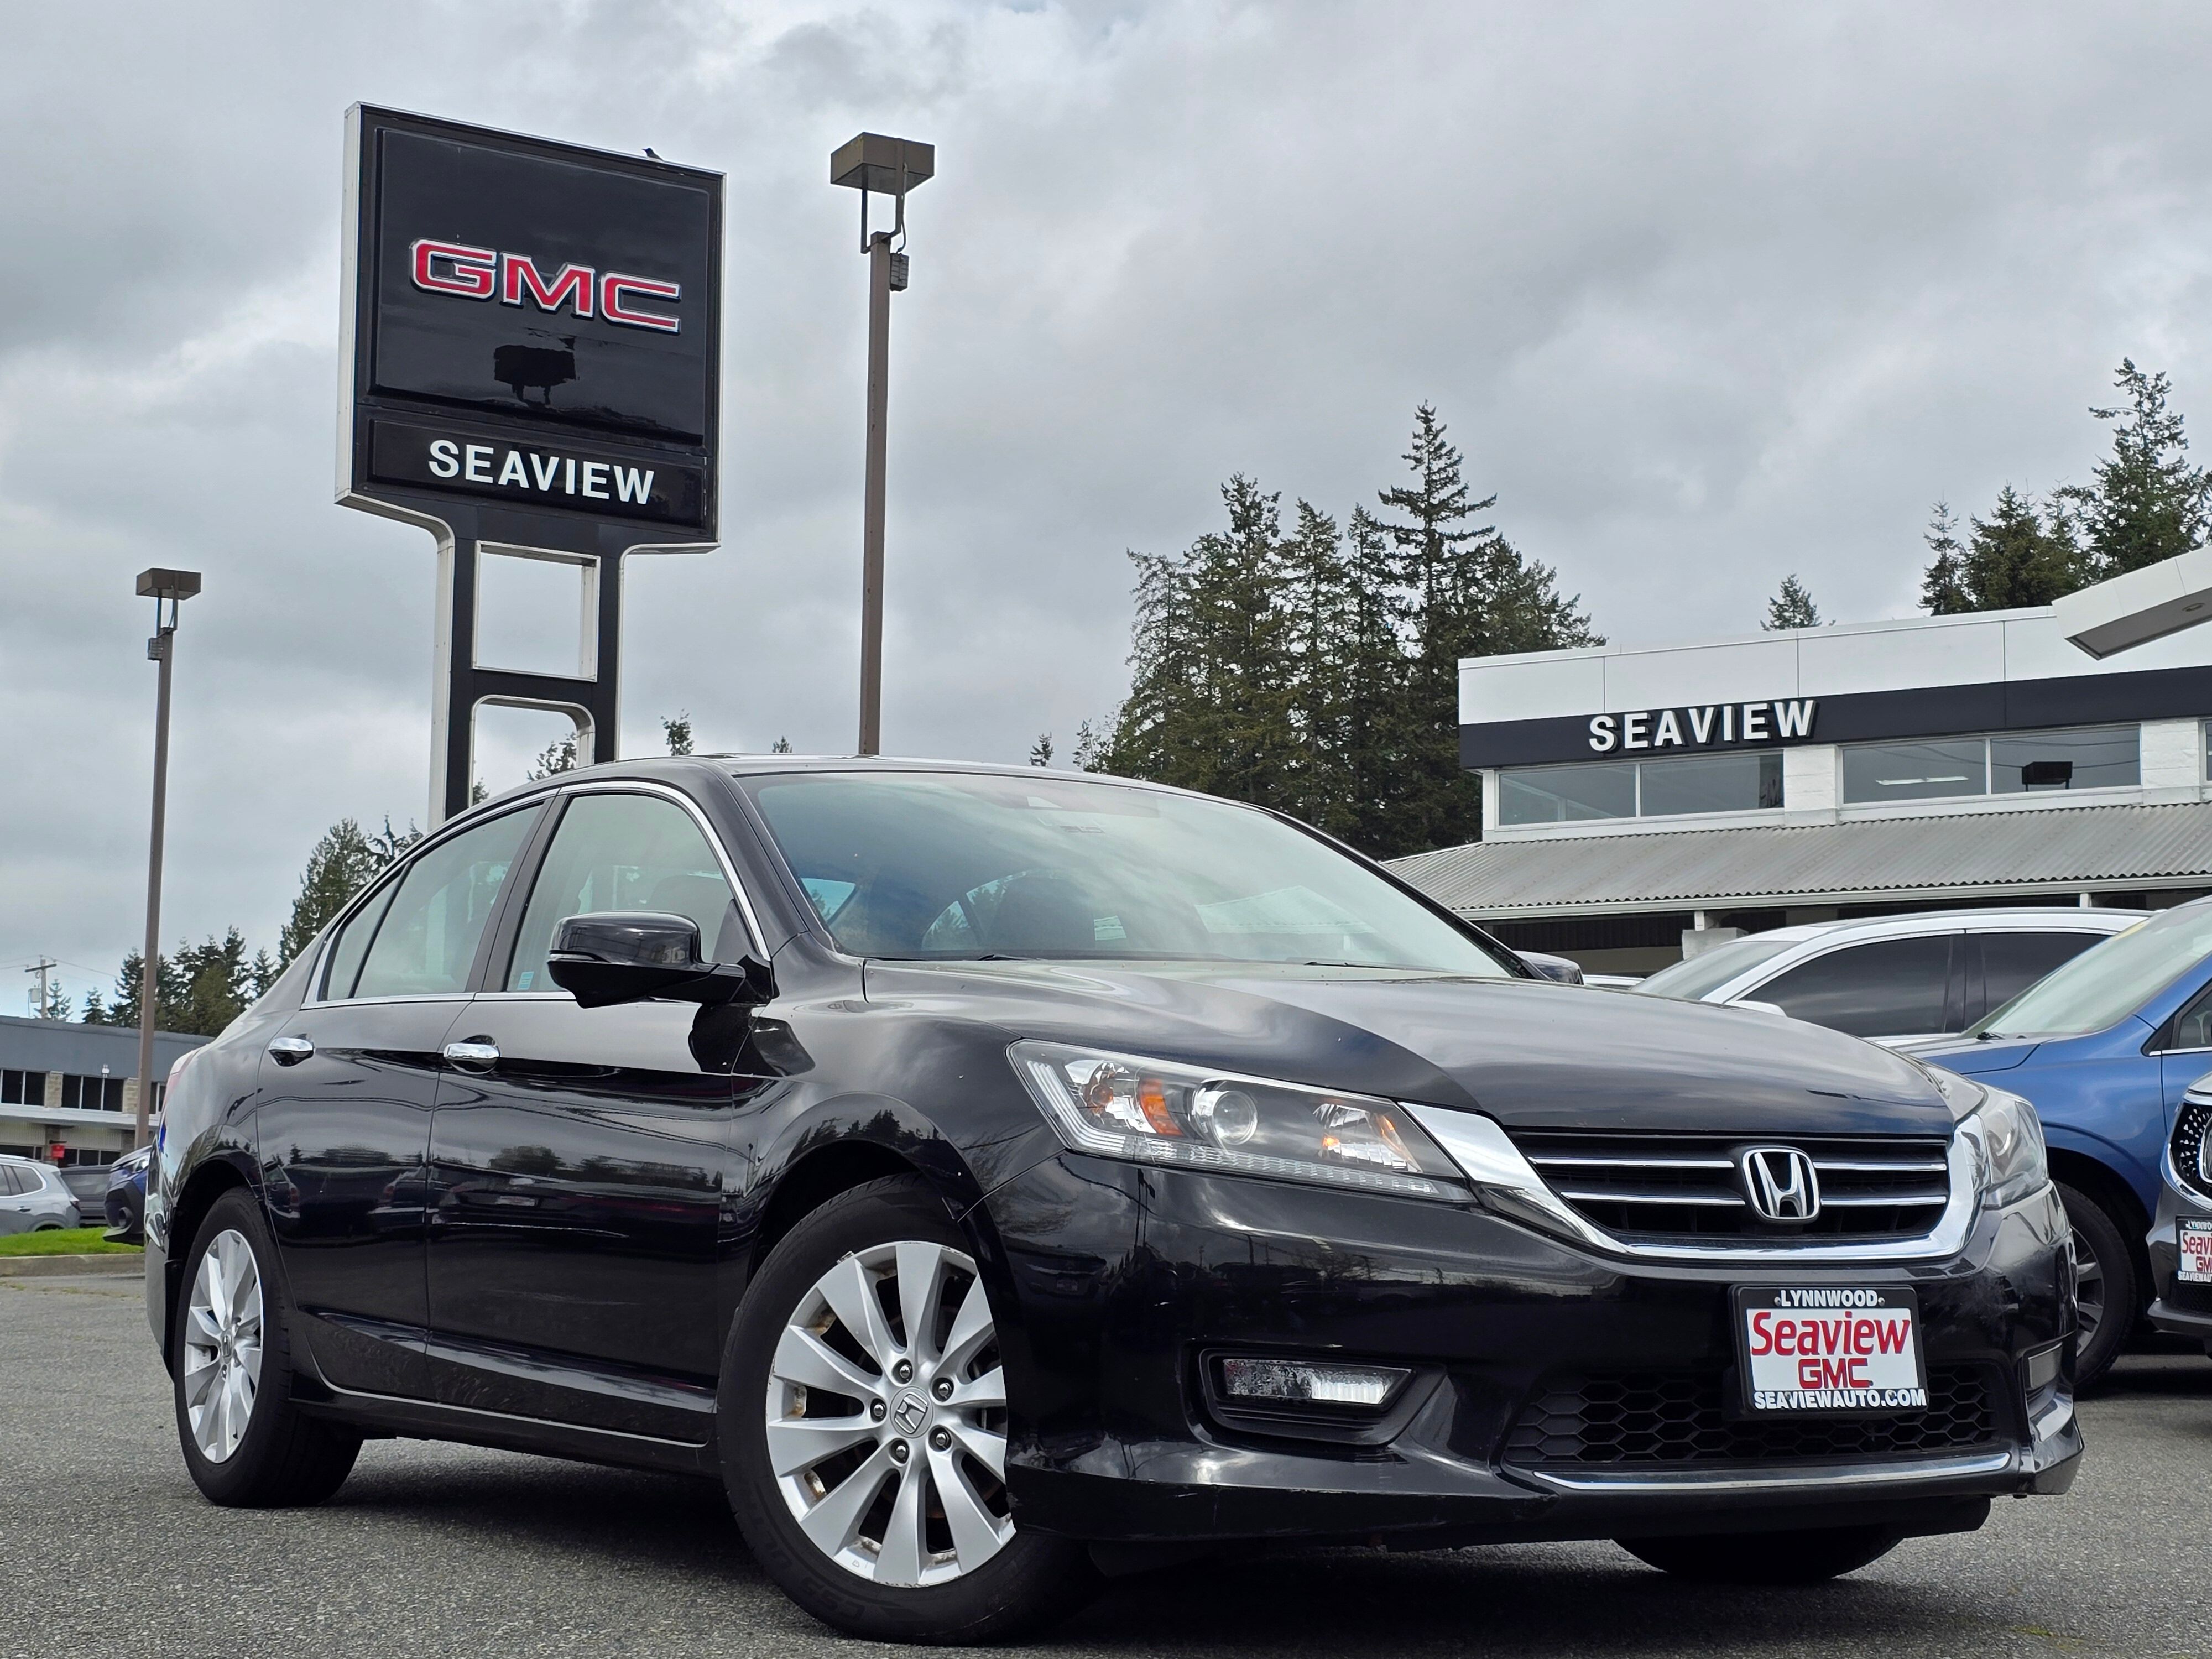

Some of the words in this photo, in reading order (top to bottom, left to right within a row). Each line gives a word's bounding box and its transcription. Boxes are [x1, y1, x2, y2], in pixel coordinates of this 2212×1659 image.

[411, 238, 681, 333] GMC
[429, 440, 655, 504] SEAVIEW
[1589, 700, 1817, 752] SEAVIEW
[2196, 1256, 2212, 1272] GM
[1780, 1290, 1879, 1307] LYNNWOOD
[1751, 1311, 1911, 1356] Seaview
[1798, 1358, 1874, 1389] GMC
[1754, 1389, 1927, 1410] SEAVIEWAUTO.COM
